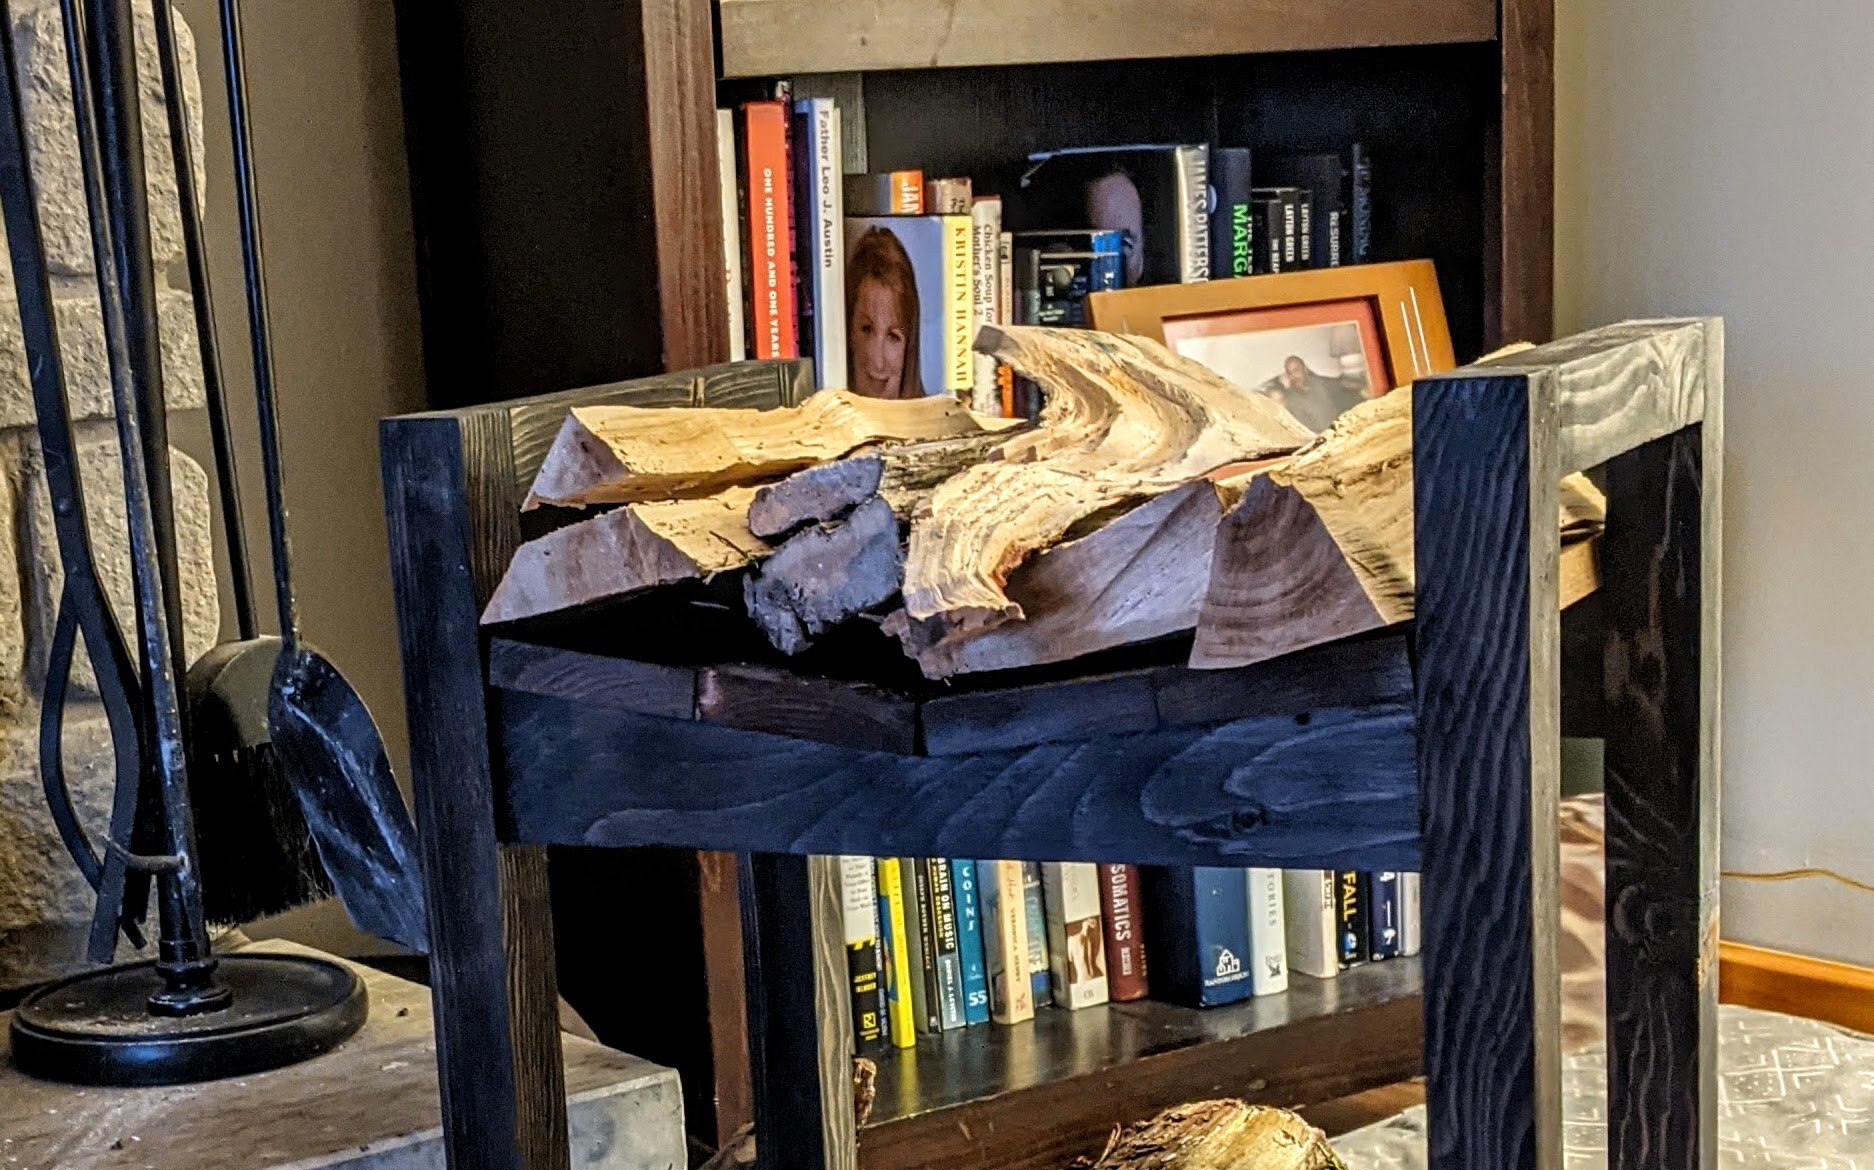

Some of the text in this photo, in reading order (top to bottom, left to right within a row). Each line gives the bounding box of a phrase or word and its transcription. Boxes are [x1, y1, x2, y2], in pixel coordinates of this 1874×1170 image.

[819, 110, 834, 268] Father Leo J. Austin
[1189, 159, 1207, 210] JAMES
[763, 168, 781, 358] ONE HUNDRED AND ONE YEARS
[973, 224, 983, 276] Mother's
[983, 224, 995, 323] Chicken Soup for
[1233, 204, 1248, 279] MARG
[955, 227, 968, 382] KRISTIN HANNAH
[973, 279, 984, 306] Soul
[936, 858, 955, 950] BRAIN ON MUSIC
[1111, 864, 1131, 941] SOMATICS
[1343, 871, 1357, 922] FALL
[968, 990, 988, 1007] 55
